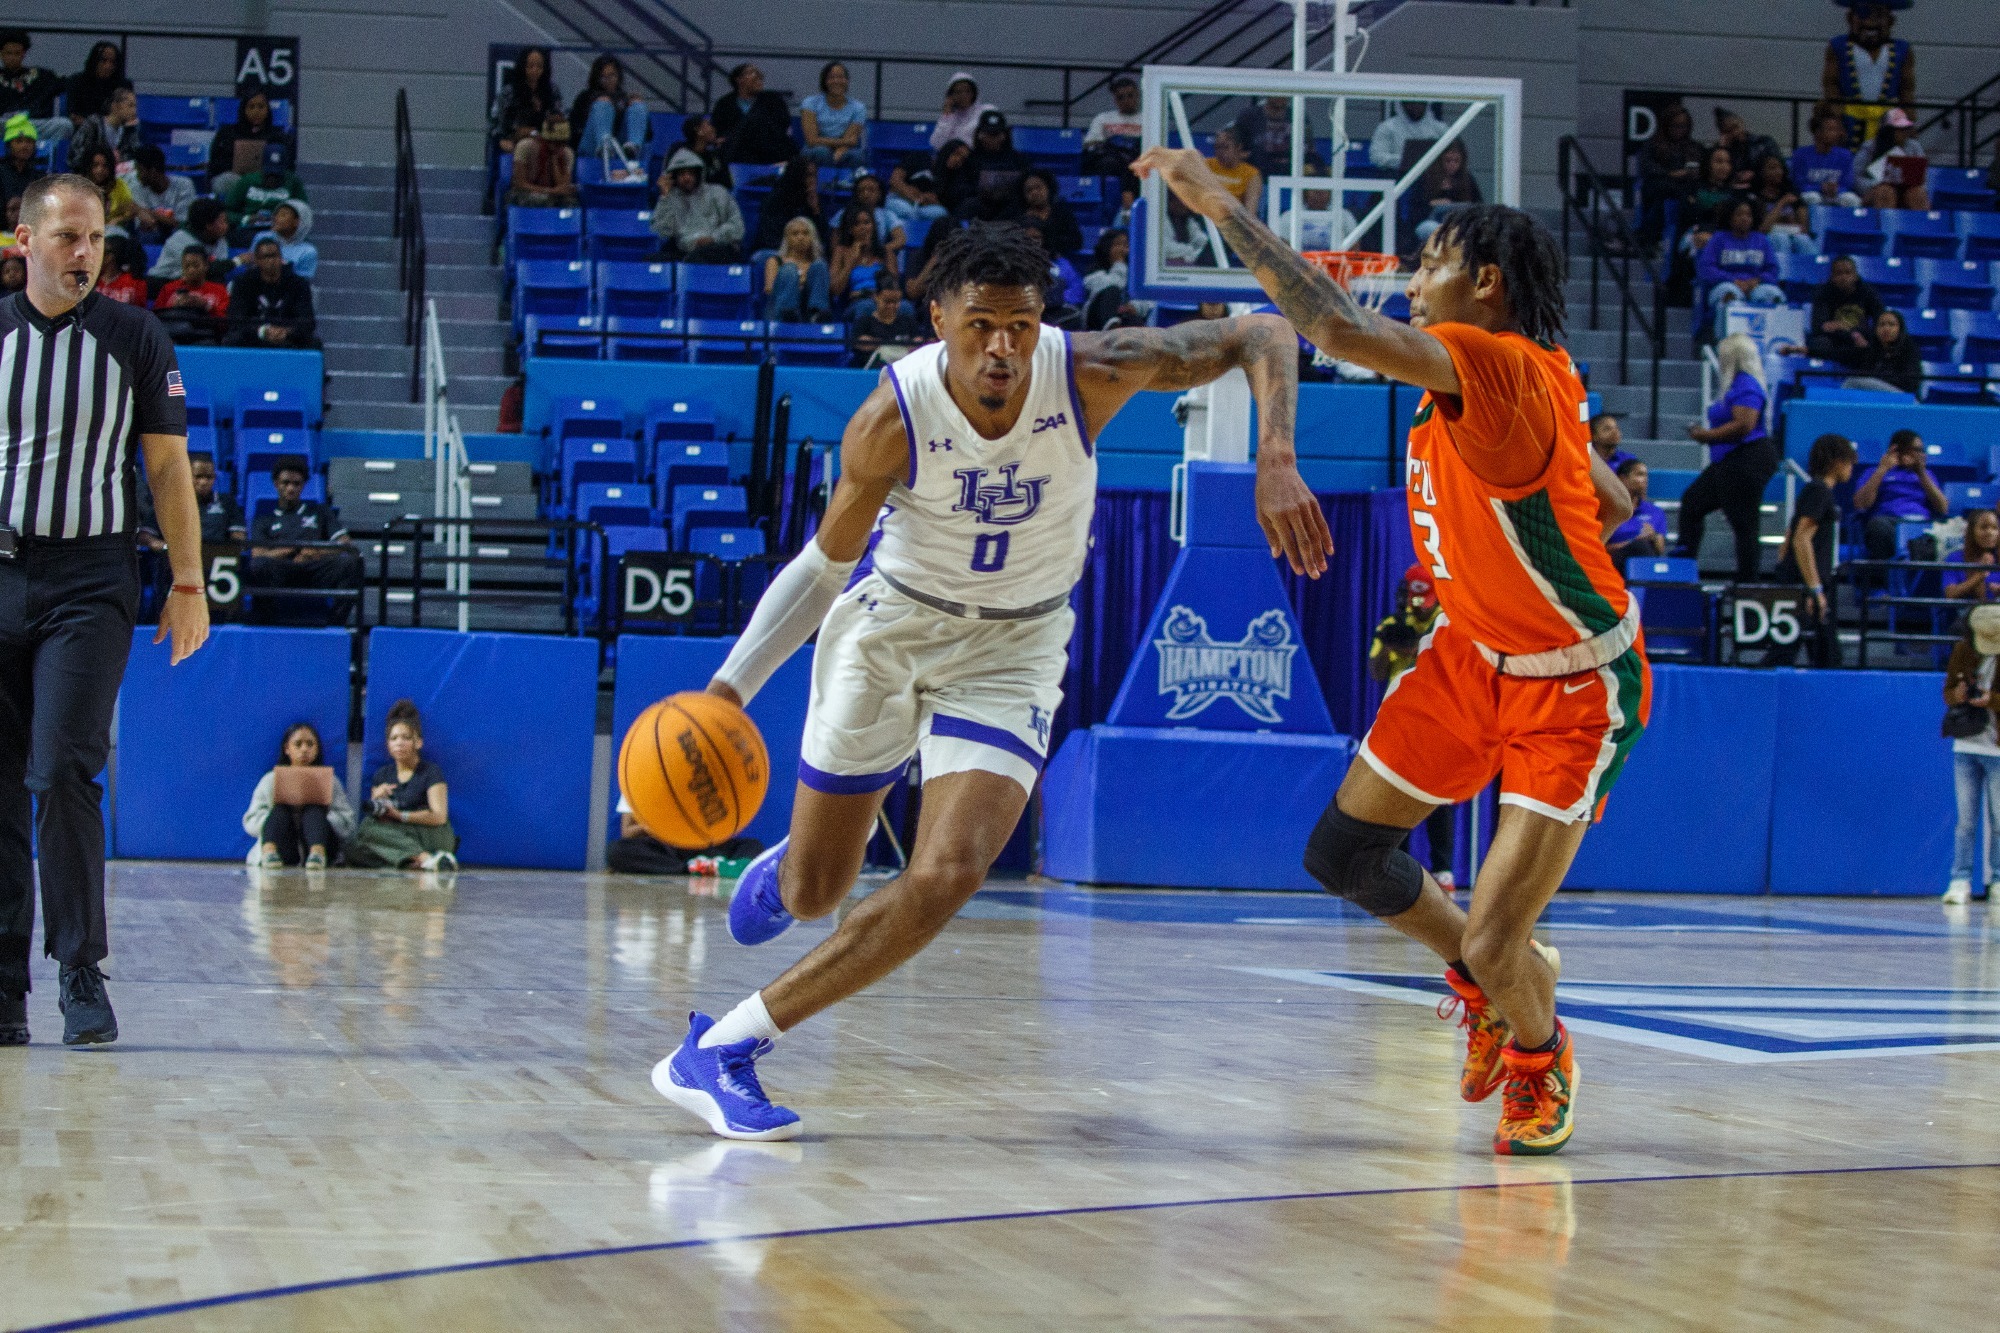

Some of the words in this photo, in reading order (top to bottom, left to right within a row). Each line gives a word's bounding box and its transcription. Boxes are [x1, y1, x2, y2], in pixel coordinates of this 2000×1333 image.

[237, 47, 294, 85] A5
[1628, 106, 1658, 141] D
[1032, 412, 1067, 433] CAA
[952, 461, 1051, 525] HU
[970, 530, 1010, 572] 0
[207, 556, 240, 603] 5
[624, 566, 695, 616] D5
[1734, 598, 1801, 645] D5
[1165, 647, 1285, 690] HAMPTON
